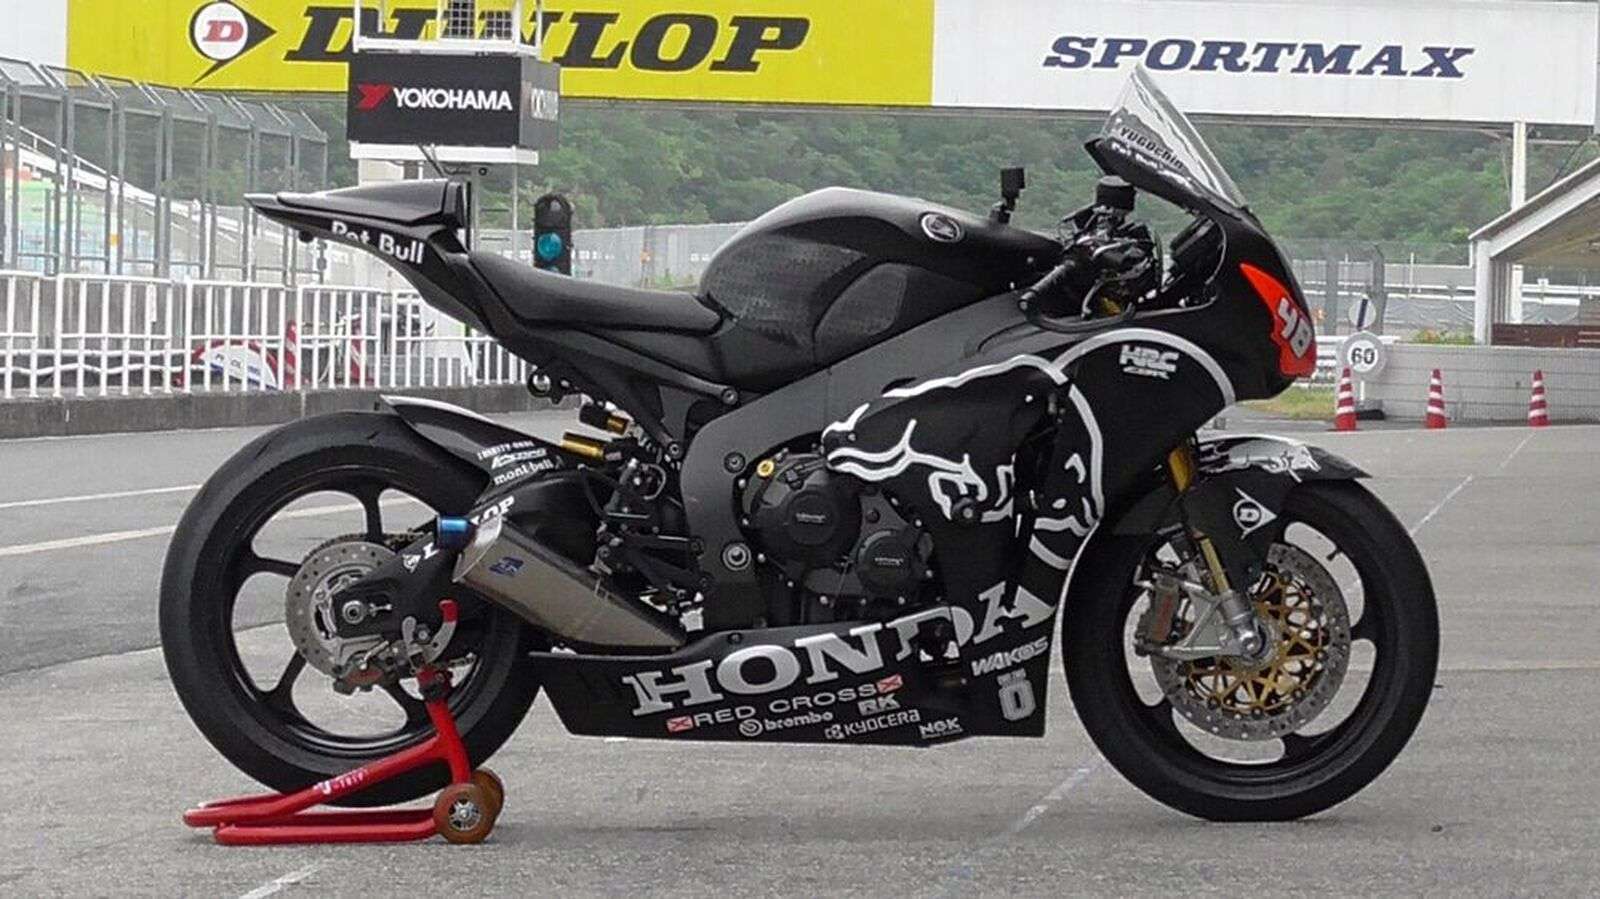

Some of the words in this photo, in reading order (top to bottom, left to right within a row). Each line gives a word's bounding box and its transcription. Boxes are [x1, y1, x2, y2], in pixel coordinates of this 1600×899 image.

[283, 6, 809, 73] DLOP
[1043, 36, 1475, 78] SPORTMAX
[394, 87, 513, 111] YOKOHAMA
[380, 233, 425, 263] Bull
[1119, 344, 1179, 372] HRC
[1351, 347, 1375, 365] 60
[622, 581, 1055, 716] HONDA
[693, 705, 756, 728] RED
[769, 683, 876, 713] CROSS
[858, 693, 900, 716] RK
[765, 711, 833, 731] brembo
[845, 708, 921, 736] KYOCERA
